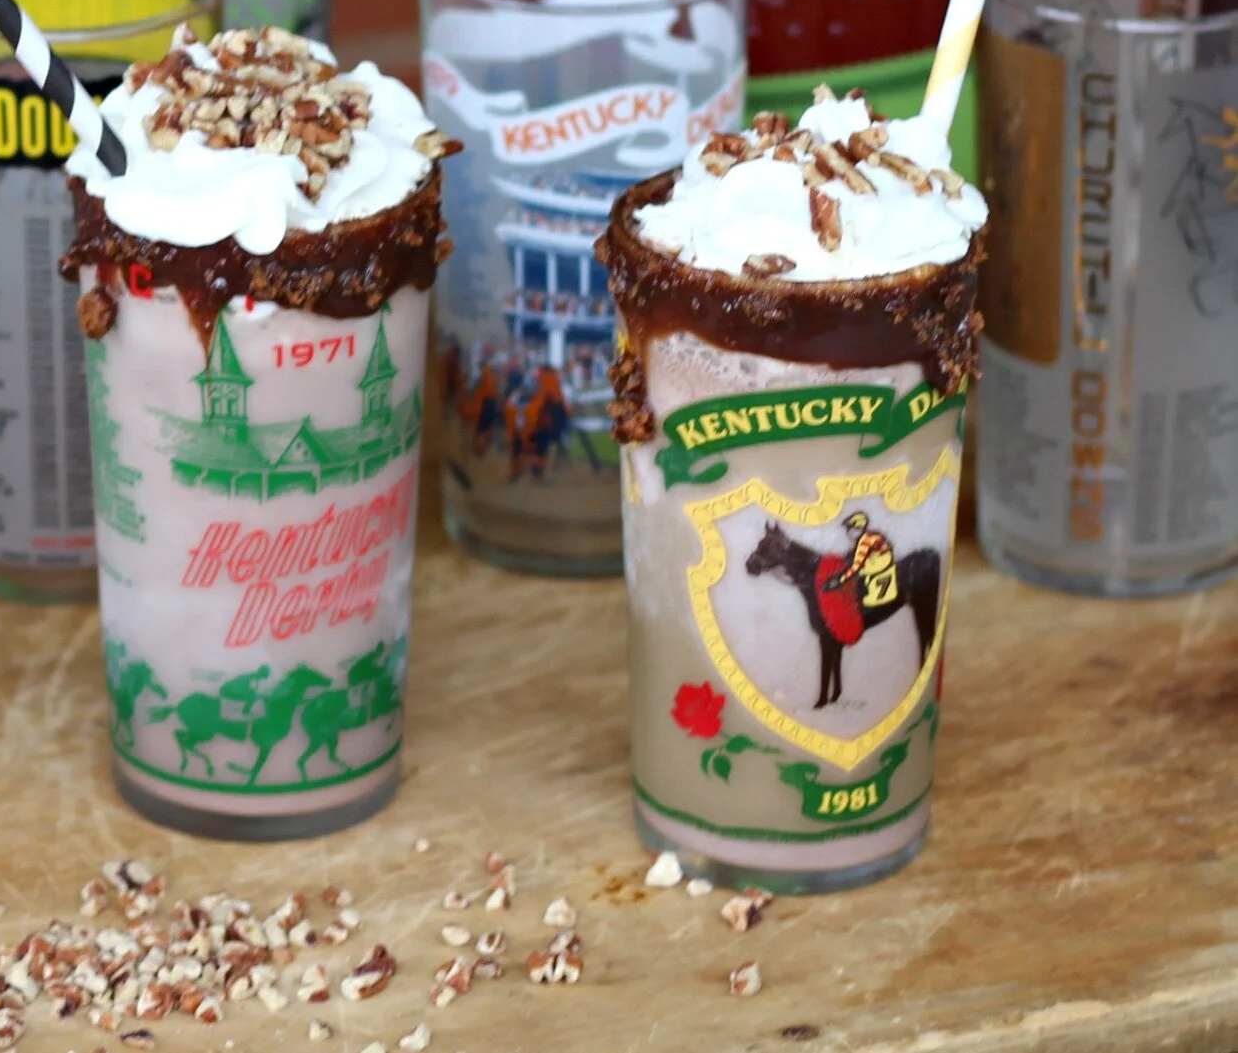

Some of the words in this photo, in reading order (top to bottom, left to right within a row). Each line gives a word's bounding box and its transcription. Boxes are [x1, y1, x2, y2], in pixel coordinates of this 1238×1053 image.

[502, 86, 678, 153] KENTUCKY
[271, 333, 356, 369] 1971
[675, 395, 885, 450] KENTUCKY
[875, 573, 893, 600] 7
[817, 780, 879, 816] 1981
